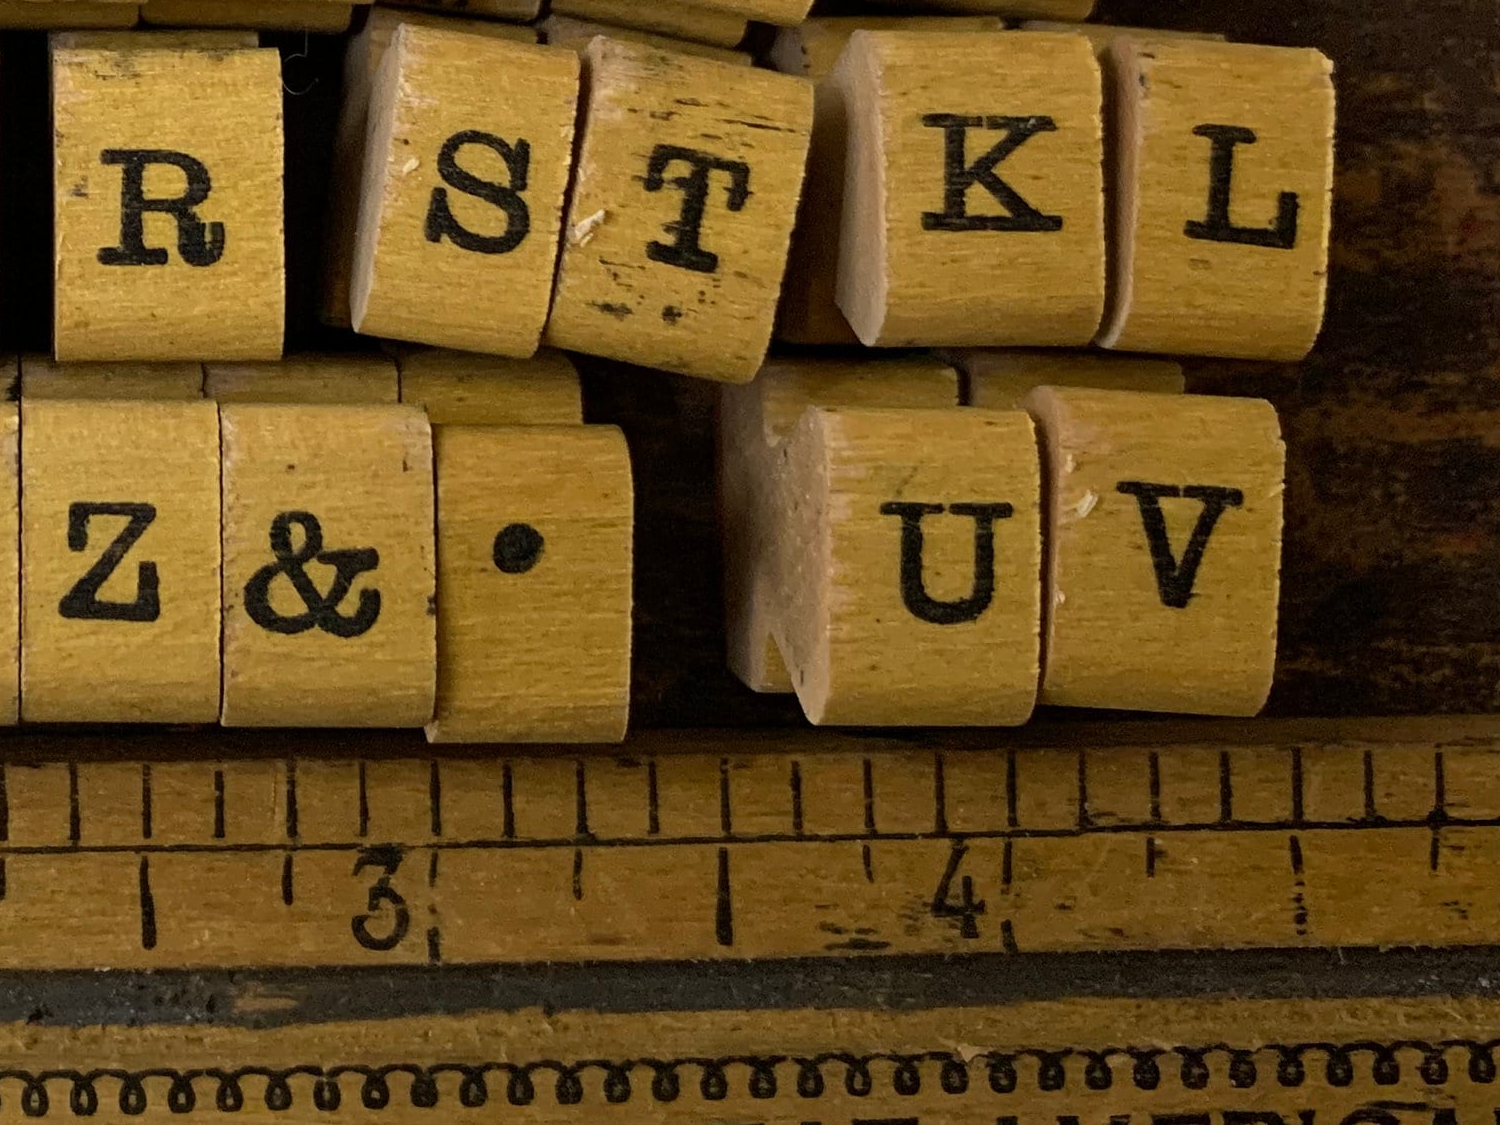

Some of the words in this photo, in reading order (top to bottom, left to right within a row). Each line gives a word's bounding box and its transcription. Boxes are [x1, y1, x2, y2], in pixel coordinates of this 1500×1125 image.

[96, 147, 226, 267] R
[423, 128, 533, 255] S
[641, 143, 752, 273] T
[920, 112, 1063, 233] K
[1182, 123, 1302, 250] L
[57, 500, 162, 622] Z
[242, 510, 382, 639] &
[879, 500, 1013, 624] U
[1116, 481, 1246, 608] V
[350, 843, 411, 952] 3
[929, 839, 988, 939] 4
